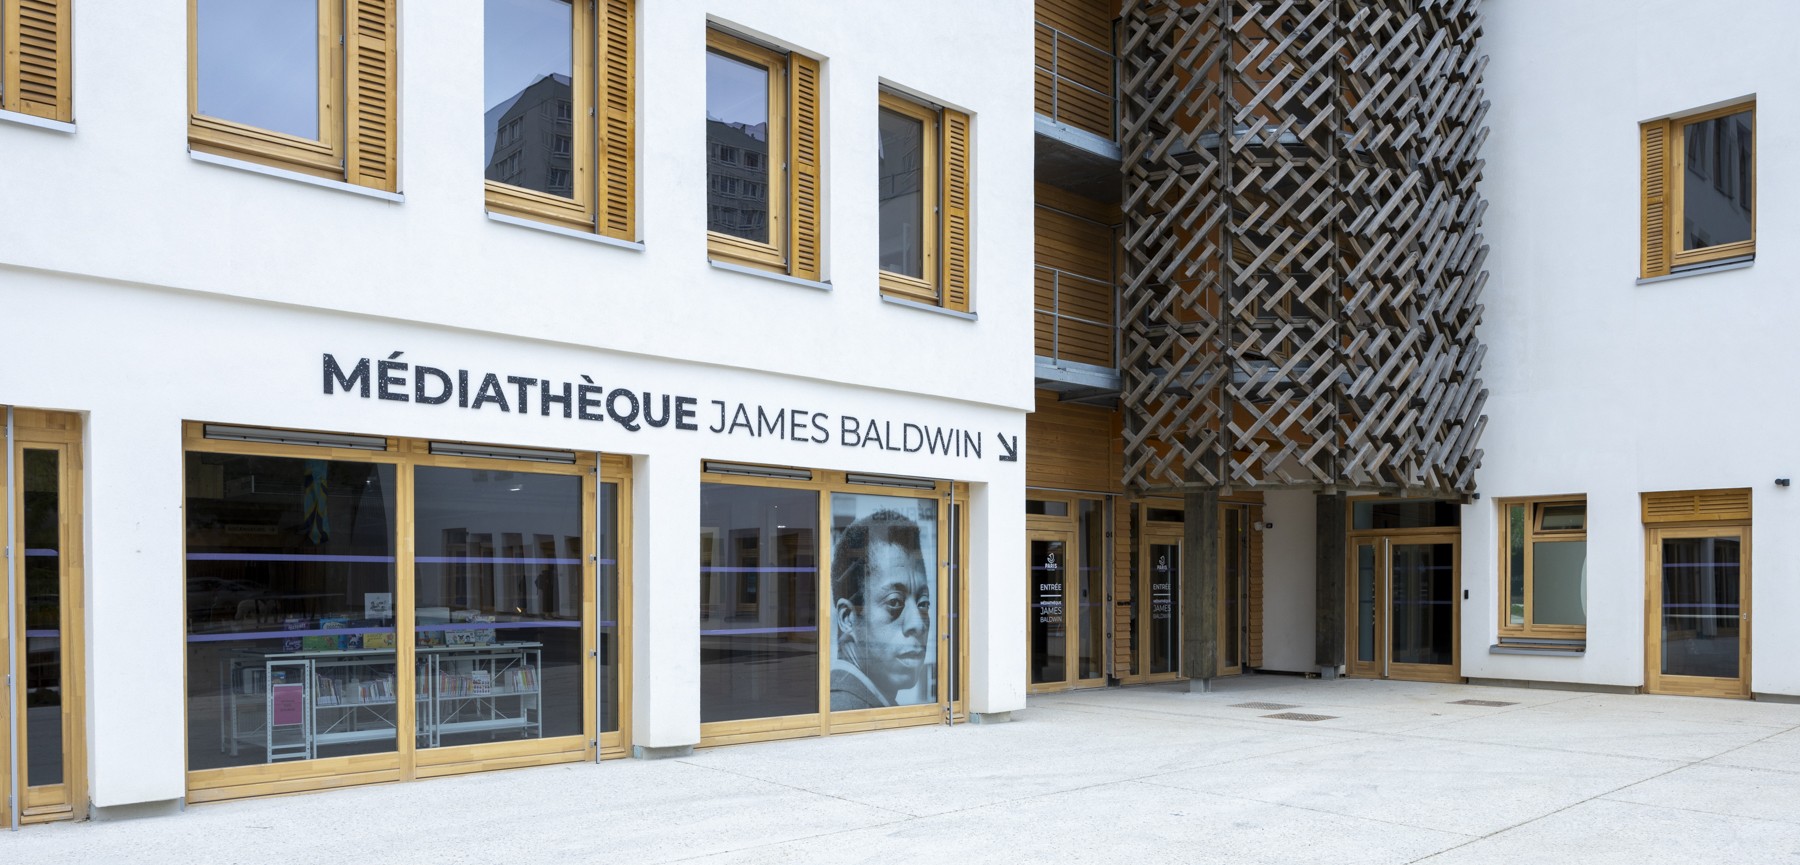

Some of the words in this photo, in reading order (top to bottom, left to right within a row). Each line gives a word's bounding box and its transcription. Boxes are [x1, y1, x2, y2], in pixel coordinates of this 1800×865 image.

[323, 351, 698, 432] MÉDIATHÈQUE
[709, 400, 830, 444] JAMES
[841, 415, 982, 459] BALDWIN
[1040, 583, 1062, 591] ENTRÉE
[1040, 606, 1062, 615] JAMES
[1153, 604, 1171, 612] JAMES
